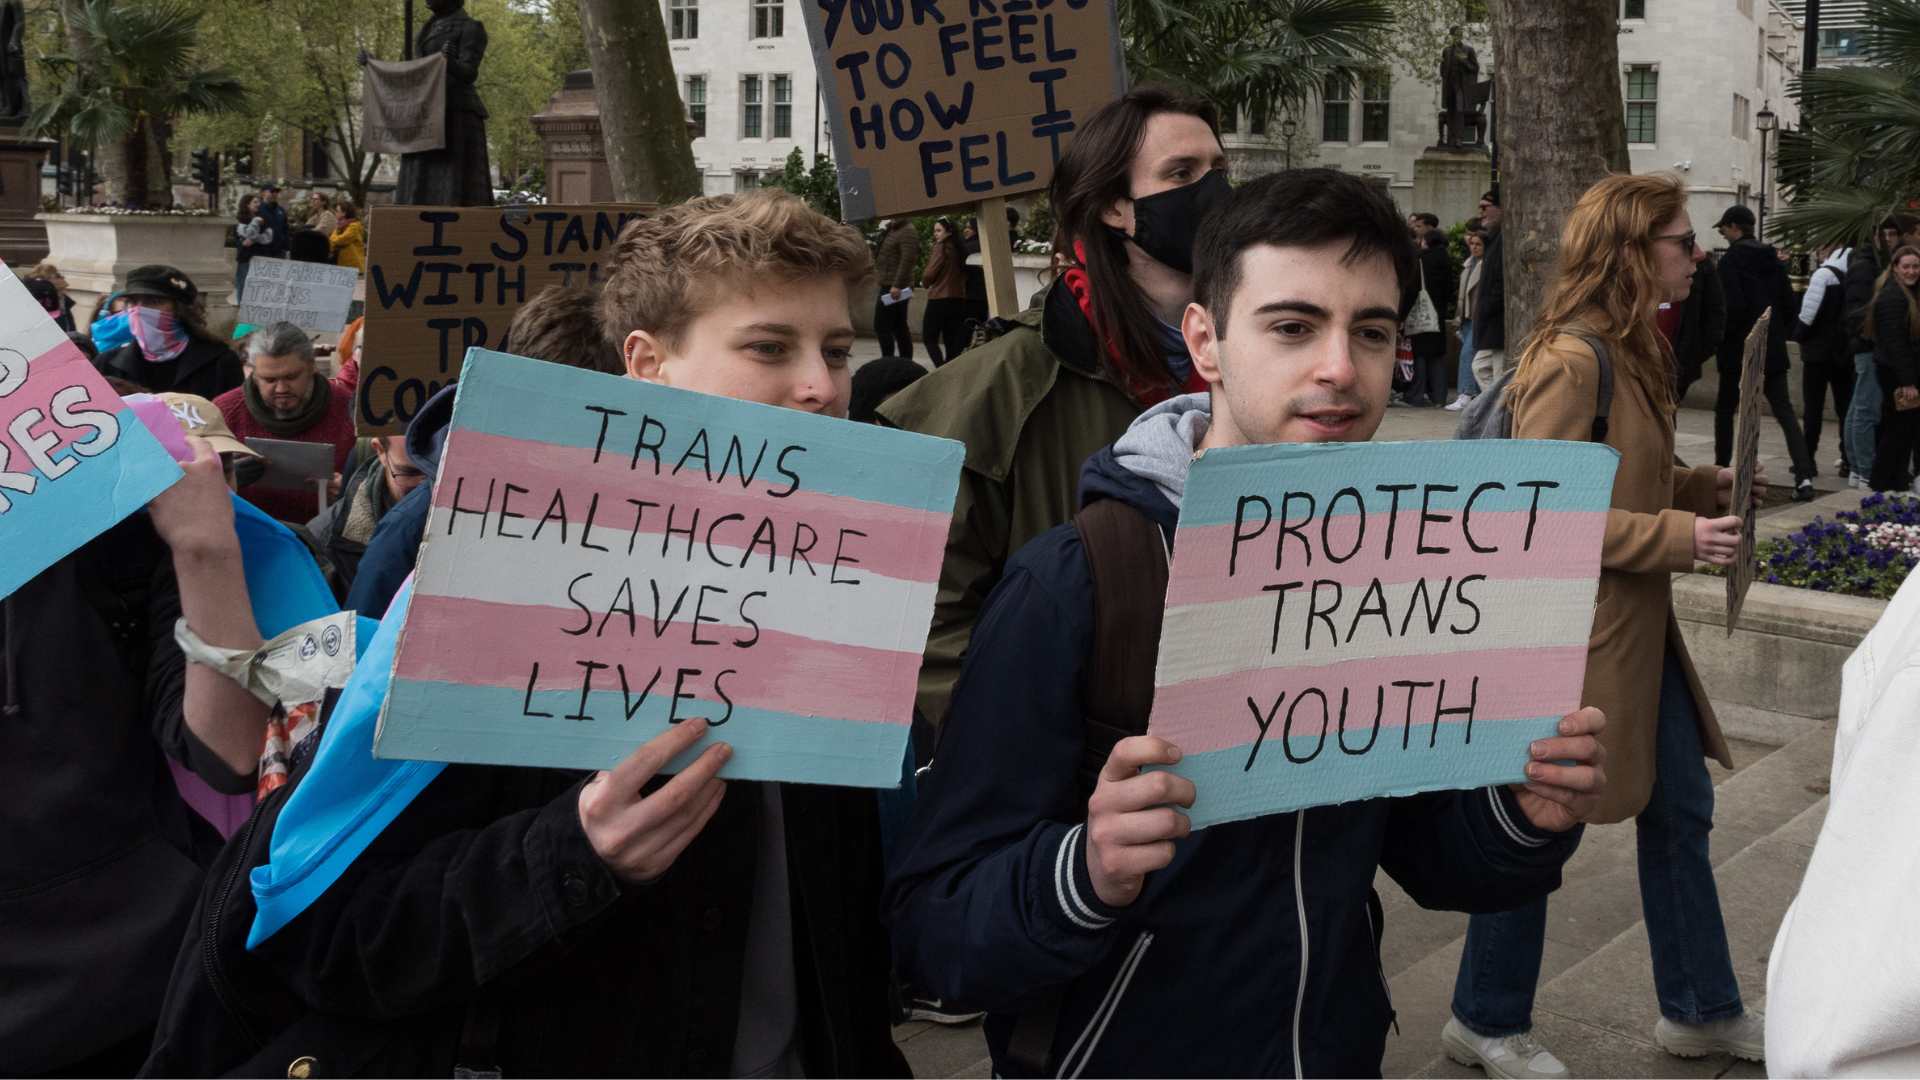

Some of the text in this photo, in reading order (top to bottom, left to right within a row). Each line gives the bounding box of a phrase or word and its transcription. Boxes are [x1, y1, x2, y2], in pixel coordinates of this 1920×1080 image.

[836, 14, 1077, 101] TO FEEL
[850, 68, 1072, 150] HOW I
[252, 261, 281, 279] WE
[286, 262, 323, 281] ARE
[413, 211, 646, 262] I STAN
[246, 279, 312, 305] TRANS
[371, 261, 526, 310] WITH
[585, 405, 808, 498] TRANS
[447, 476, 868, 586] HEALTHCARE
[1229, 481, 1560, 577] PROTECT
[560, 572, 768, 649] SAVES
[1262, 574, 1488, 655] TRANS
[523, 660, 738, 728] LIVES
[1244, 676, 1480, 772] YOUTH
